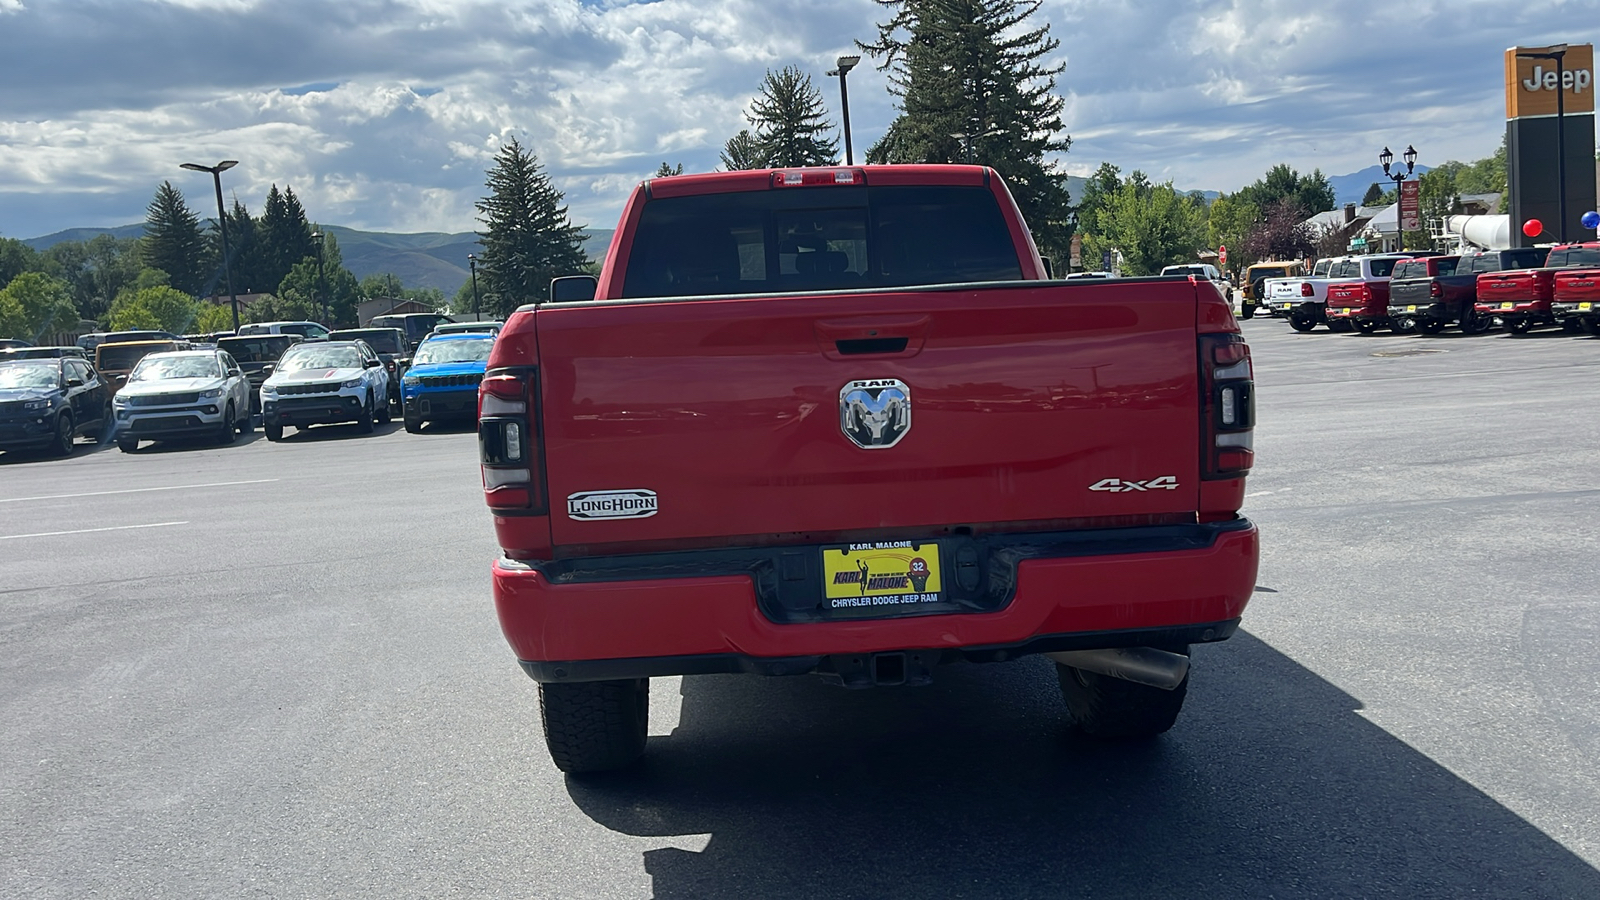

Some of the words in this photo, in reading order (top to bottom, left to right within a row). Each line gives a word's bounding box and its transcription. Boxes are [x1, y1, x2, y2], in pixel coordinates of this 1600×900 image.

[1523, 66, 1590, 93] Jeep
[1088, 475, 1180, 492] 4x4
[570, 498, 655, 513] LONGHORN
[849, 543, 873, 551] KARL
[876, 541, 912, 549] MALONE
[912, 562, 924, 571] 32
[833, 571, 861, 585] KARL
[867, 576, 909, 590] MALONE
[831, 597, 871, 608] CHRYSLER
[872, 595, 899, 605] DODGE
[900, 594, 919, 603] JEEP
[920, 593, 938, 602] RAM
